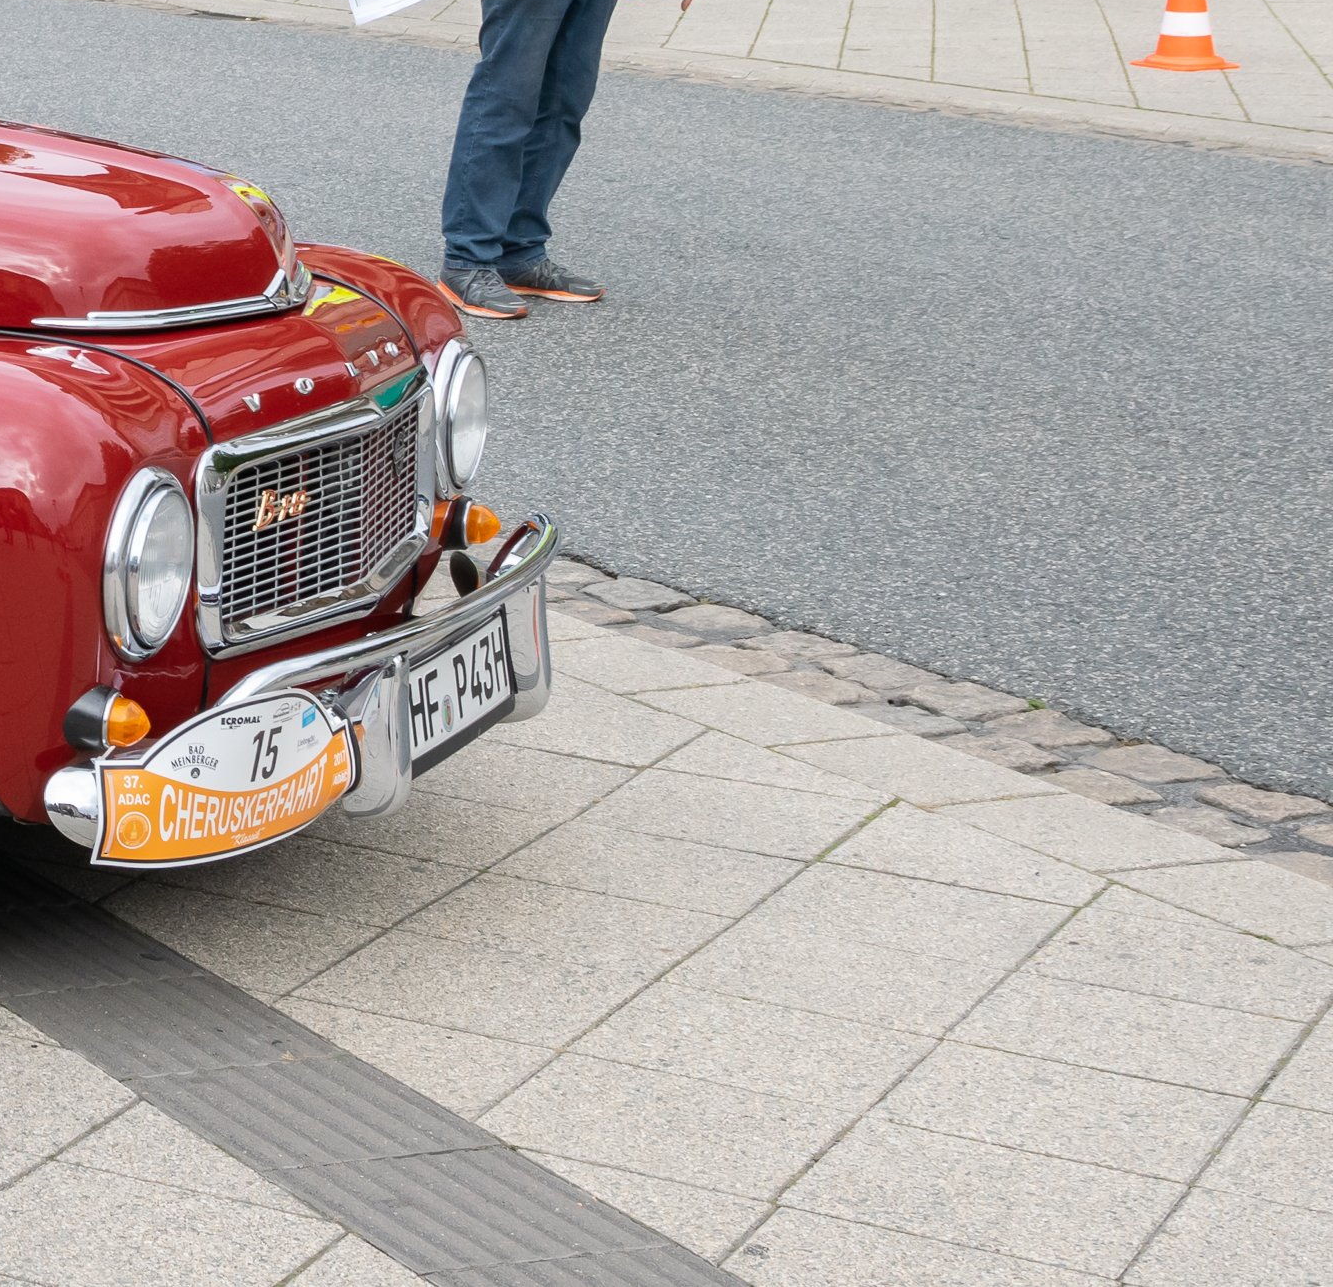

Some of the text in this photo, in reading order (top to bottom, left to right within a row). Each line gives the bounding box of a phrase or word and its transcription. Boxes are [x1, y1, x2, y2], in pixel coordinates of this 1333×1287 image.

[241, 341, 400, 413] VOLVO
[409, 668, 439, 748] HF
[220, 716, 261, 726] ECROMAL
[188, 745, 205, 755] BAD
[250, 725, 283, 783] 15
[333, 749, 346, 767] 2017
[170, 754, 219, 769] MEINBERGER
[123, 775, 144, 789] 37.
[117, 793, 151, 806] ADAC
[159, 751, 328, 842] CHERUSKERFAHRT
